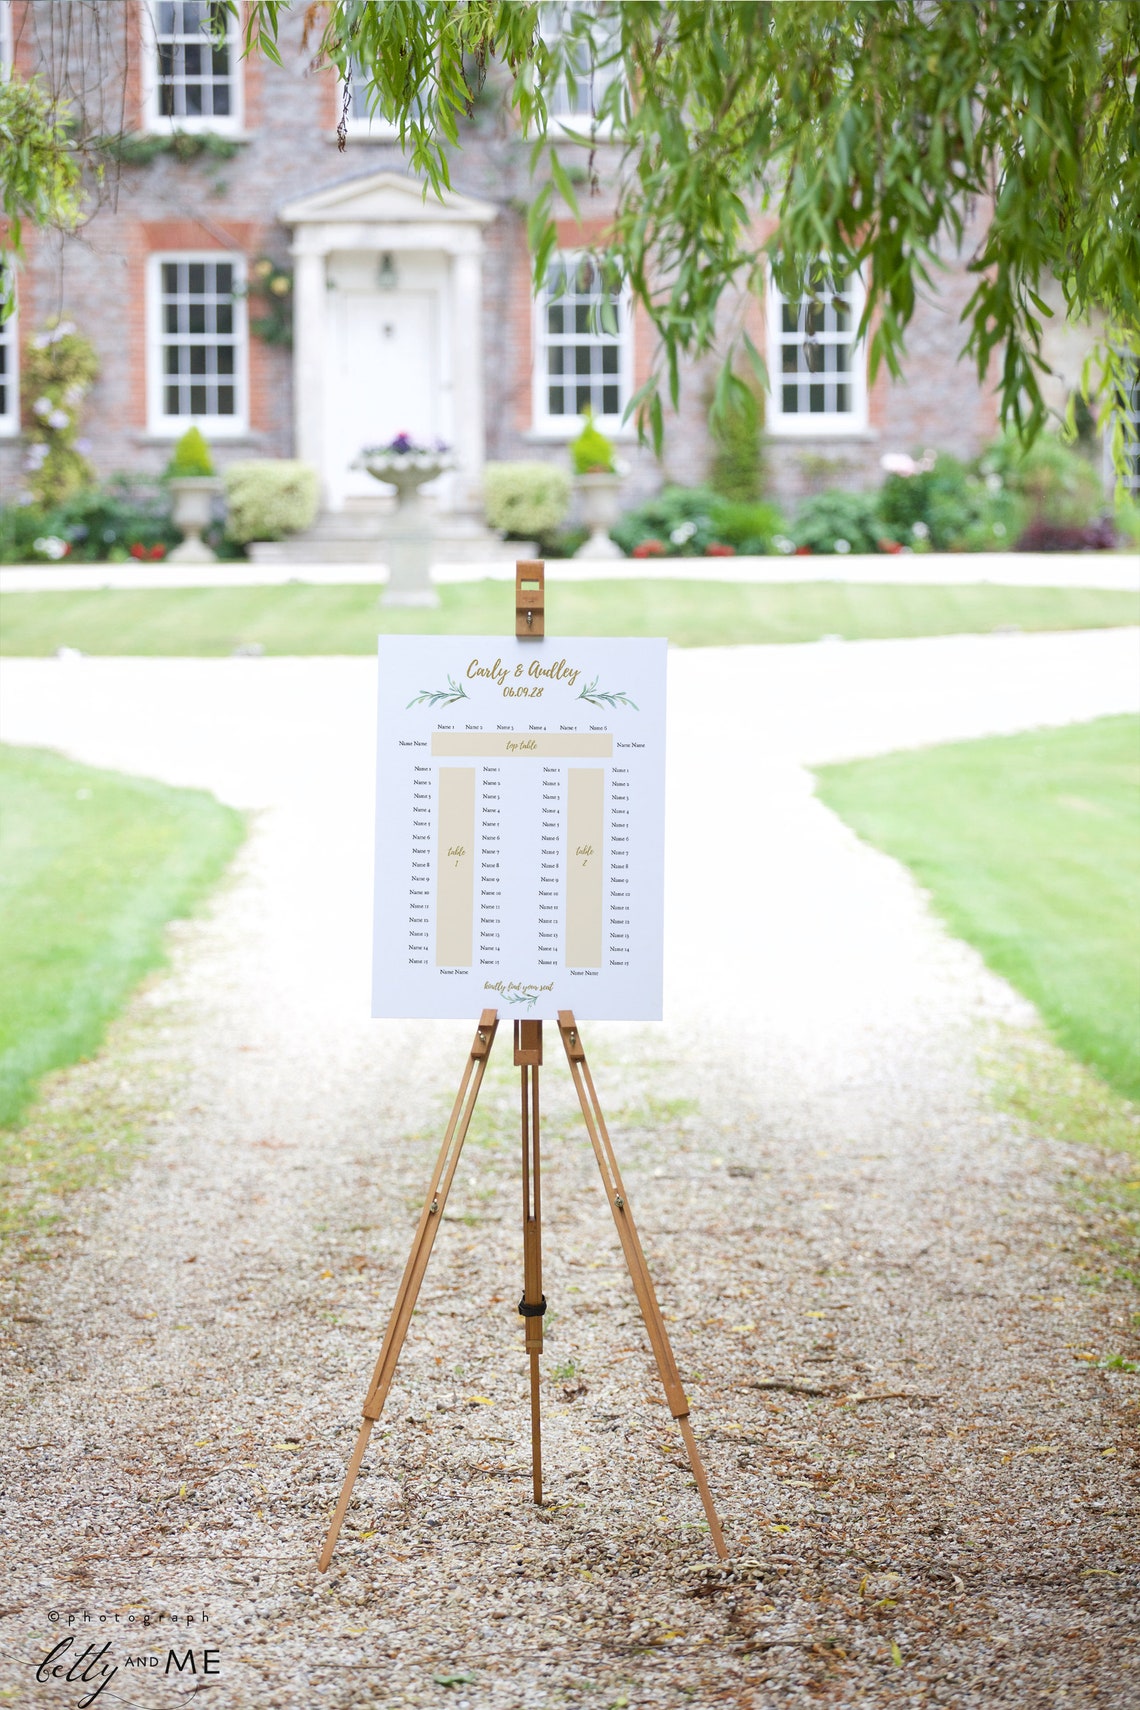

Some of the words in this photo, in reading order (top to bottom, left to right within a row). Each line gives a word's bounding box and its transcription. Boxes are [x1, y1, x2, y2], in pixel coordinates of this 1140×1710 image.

[466, 658, 510, 686] Carly
[514, 663, 524, 677] &
[528, 658, 581, 686] Audley
[503, 686, 544, 698] 06.09.28
[506, 740, 519, 752] top
[519, 739, 537, 750] table
[447, 845, 465, 856] table
[575, 844, 594, 856] table
[484, 981, 506, 993] kindly
[507, 981, 521, 992] find
[522, 984, 538, 993] your
[539, 982, 554, 991] seat
